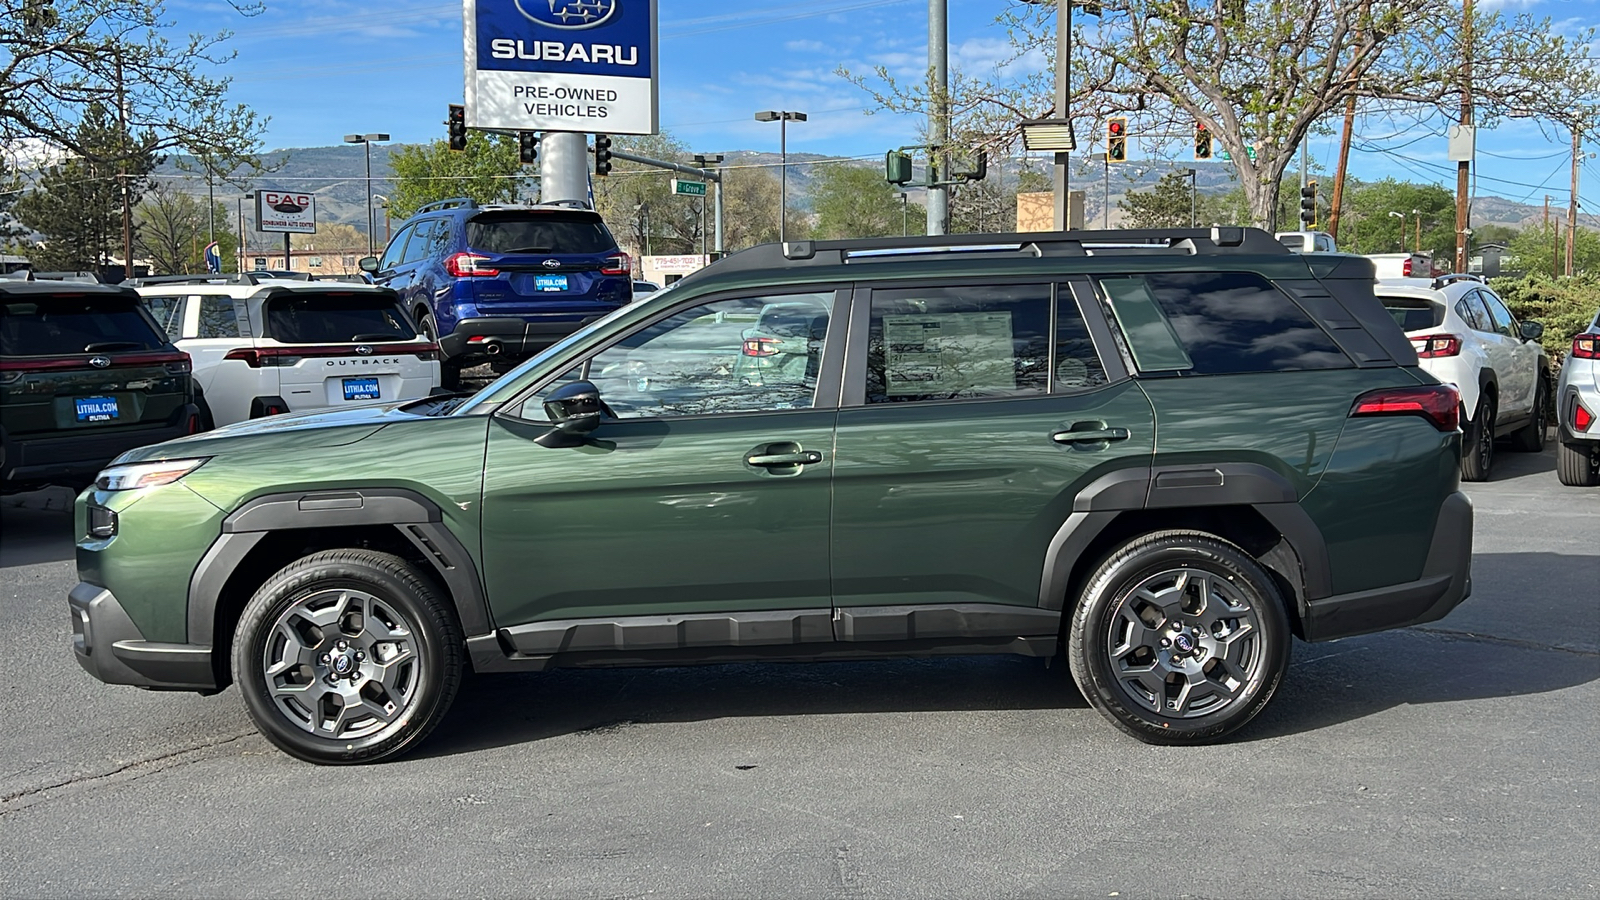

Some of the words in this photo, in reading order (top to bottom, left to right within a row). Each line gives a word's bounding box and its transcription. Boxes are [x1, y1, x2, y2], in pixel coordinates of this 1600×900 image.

[491, 38, 638, 66] SUBARU
[514, 85, 617, 102] PRE-OWNED
[524, 103, 608, 118] VEHICLES
[535, 279, 568, 287] LITHIA.COM
[326, 358, 400, 367] OUTBACK
[344, 384, 378, 394] LITHIA.COM
[76, 402, 118, 415] LITHIA.COM
